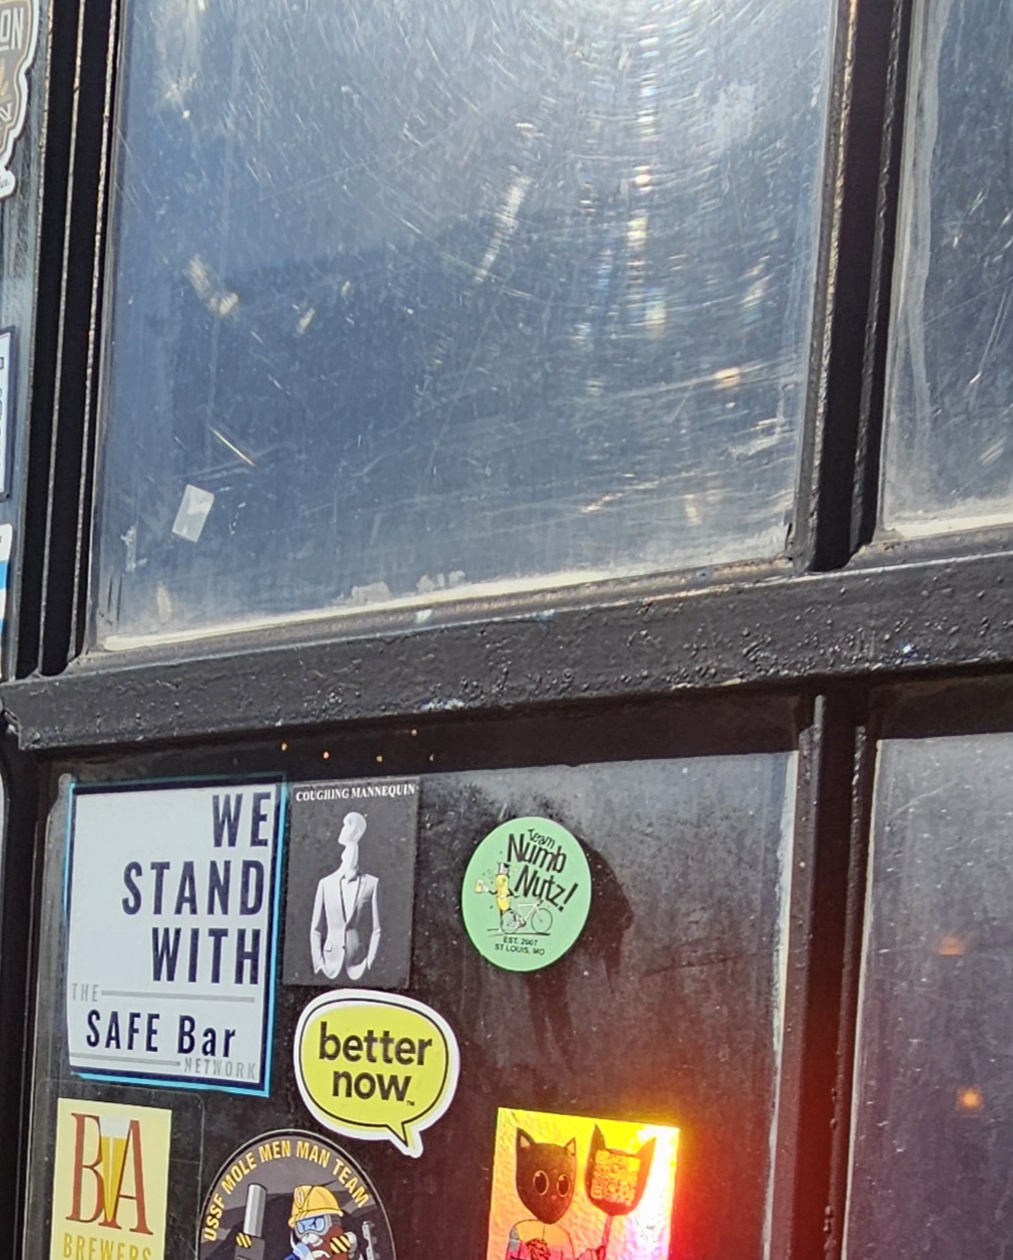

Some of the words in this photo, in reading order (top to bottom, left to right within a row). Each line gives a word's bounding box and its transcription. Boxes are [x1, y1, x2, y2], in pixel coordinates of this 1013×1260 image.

[296, 787, 351, 802] COUGHING
[351, 784, 416, 799] MANNEQUIN
[212, 792, 272, 848] WE
[527, 828, 556, 849] Team
[507, 833, 567, 874] Numb
[121, 859, 265, 916] STAND
[513, 864, 579, 913] Nutz!
[151, 926, 261, 985] WITH
[533, 946, 545, 956] MO
[72, 982, 99, 1002] THE
[85, 1008, 161, 1052] SAFE
[177, 1014, 237, 1058] Bar
[318, 1021, 433, 1066] better
[184, 1057, 257, 1080] NETWORK
[332, 1070, 412, 1103] now
[65, 1112, 154, 1236] BA
[203, 1194, 226, 1242] USSF
[221, 1152, 257, 1195] MOLE
[258, 1140, 291, 1163] MEN
[295, 1140, 331, 1169] MAN
[333, 1158, 370, 1209] TEAM
